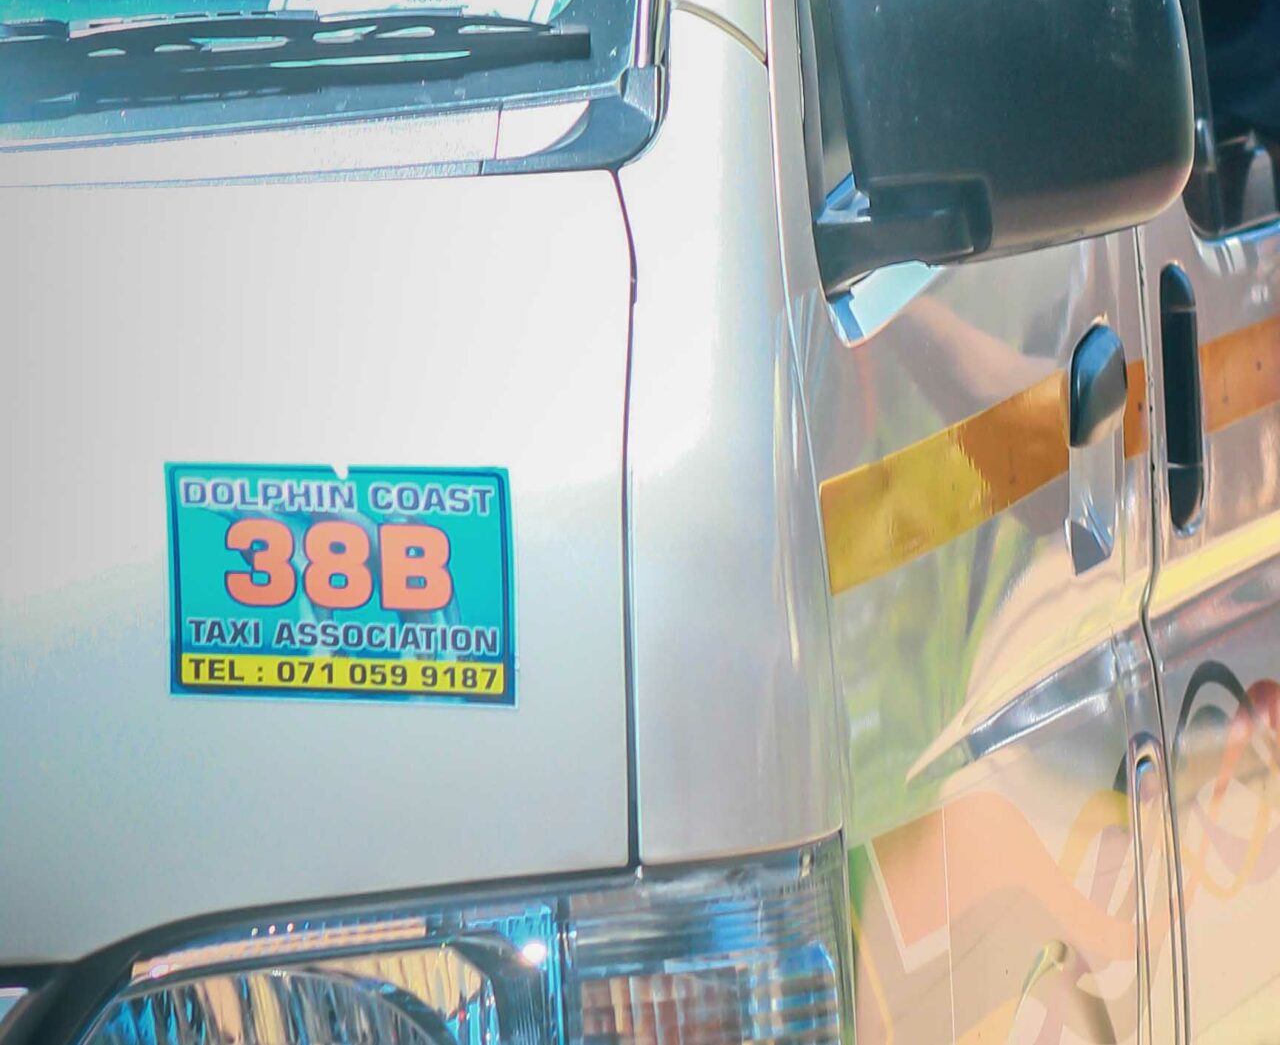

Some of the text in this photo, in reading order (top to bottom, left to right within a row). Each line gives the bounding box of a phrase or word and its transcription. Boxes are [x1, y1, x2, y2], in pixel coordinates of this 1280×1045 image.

[182, 480, 493, 513] DOLPHIN COAST
[224, 518, 453, 611] 38B
[188, 618, 497, 654] TAXI ASSOCIATION
[276, 661, 334, 684] 071
[349, 664, 408, 687] 059
[420, 666, 498, 690] 9187
